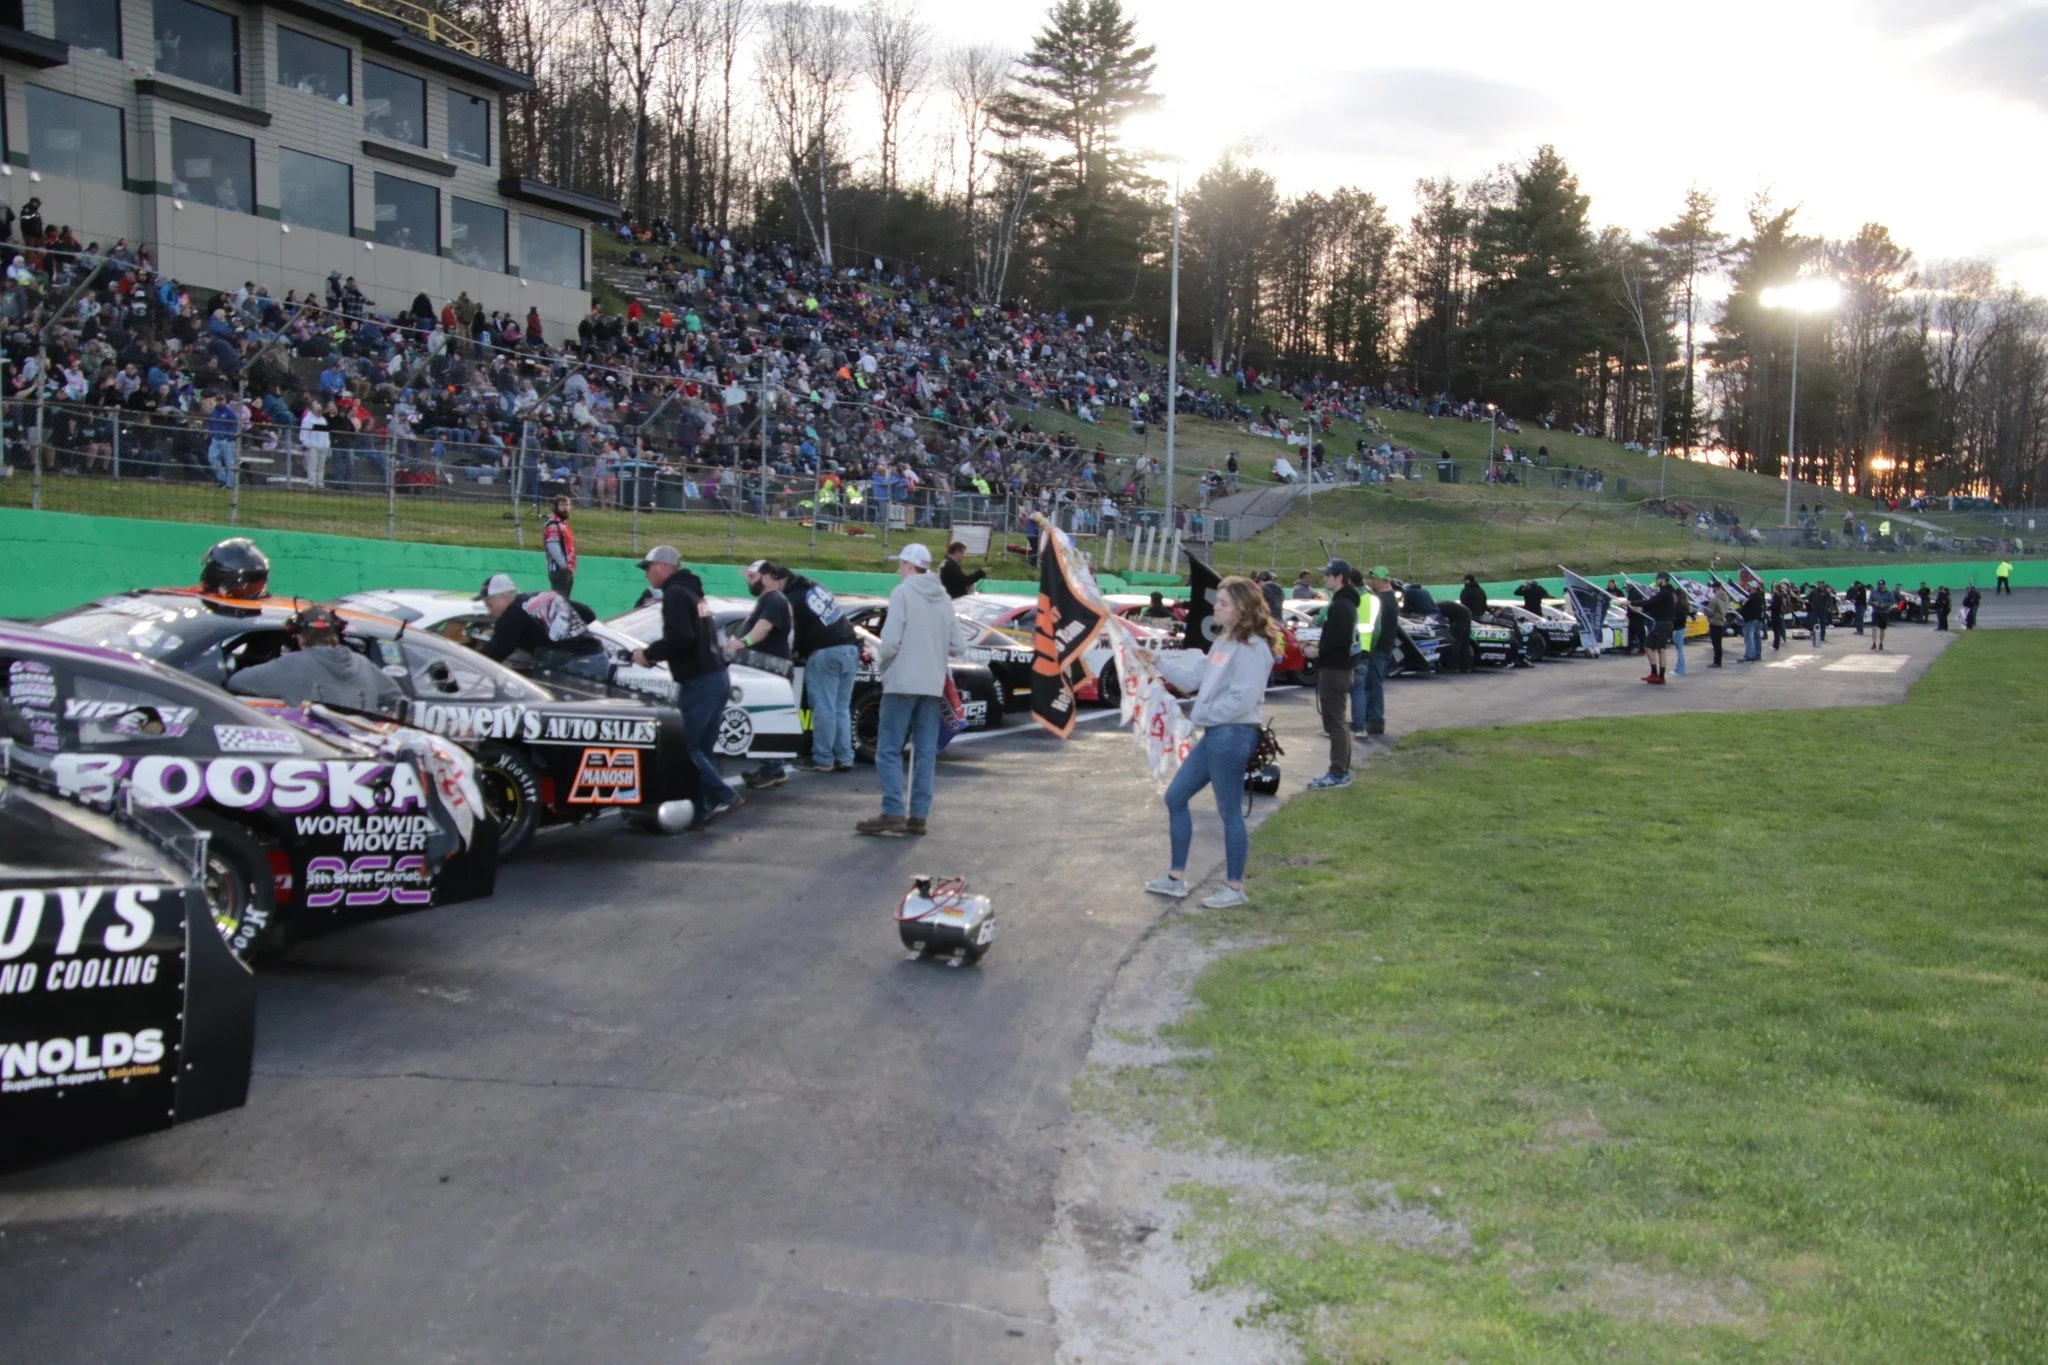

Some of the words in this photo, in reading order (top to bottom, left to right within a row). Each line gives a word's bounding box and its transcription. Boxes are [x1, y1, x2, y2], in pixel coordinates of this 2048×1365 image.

[965, 649, 1008, 662] remier
[545, 718, 598, 741] AUTO
[600, 720, 657, 744] SALES
[50, 752, 428, 812] BOOSKA
[580, 769, 635, 786] MANOSH
[295, 816, 428, 836] WORLDWID
[343, 834, 428, 852] MOVER
[46, 954, 160, 992] COOLING
[56, 1069, 106, 1087] Support.
[108, 1064, 160, 1080] Solutions
